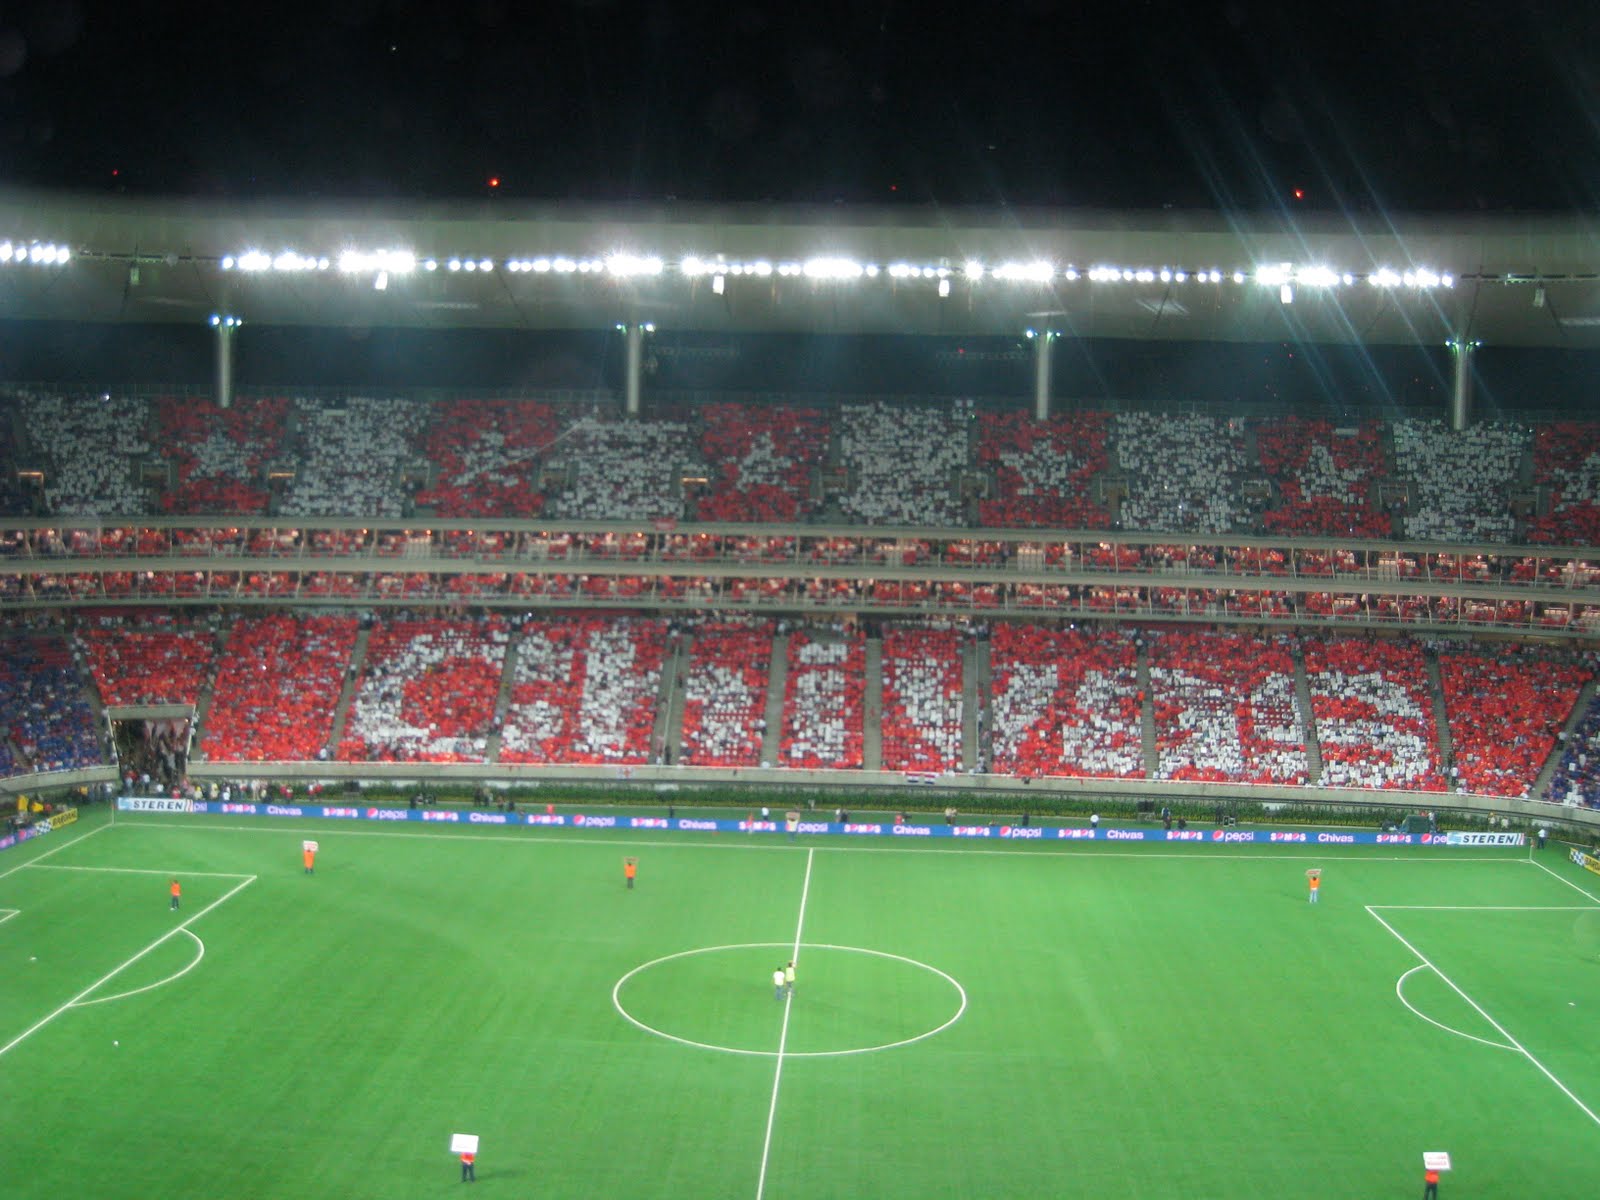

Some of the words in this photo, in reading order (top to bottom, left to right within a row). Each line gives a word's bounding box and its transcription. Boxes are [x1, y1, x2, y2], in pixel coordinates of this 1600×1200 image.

[133, 799, 184, 811] STEREN
[267, 805, 302, 816] Chivas
[469, 812, 506, 823] Chivas
[679, 819, 717, 830] Chivas
[893, 825, 931, 836] Chivas
[1106, 829, 1144, 840] Chivas
[1318, 833, 1354, 843] Chivas
[1462, 834, 1515, 844] STEREN
